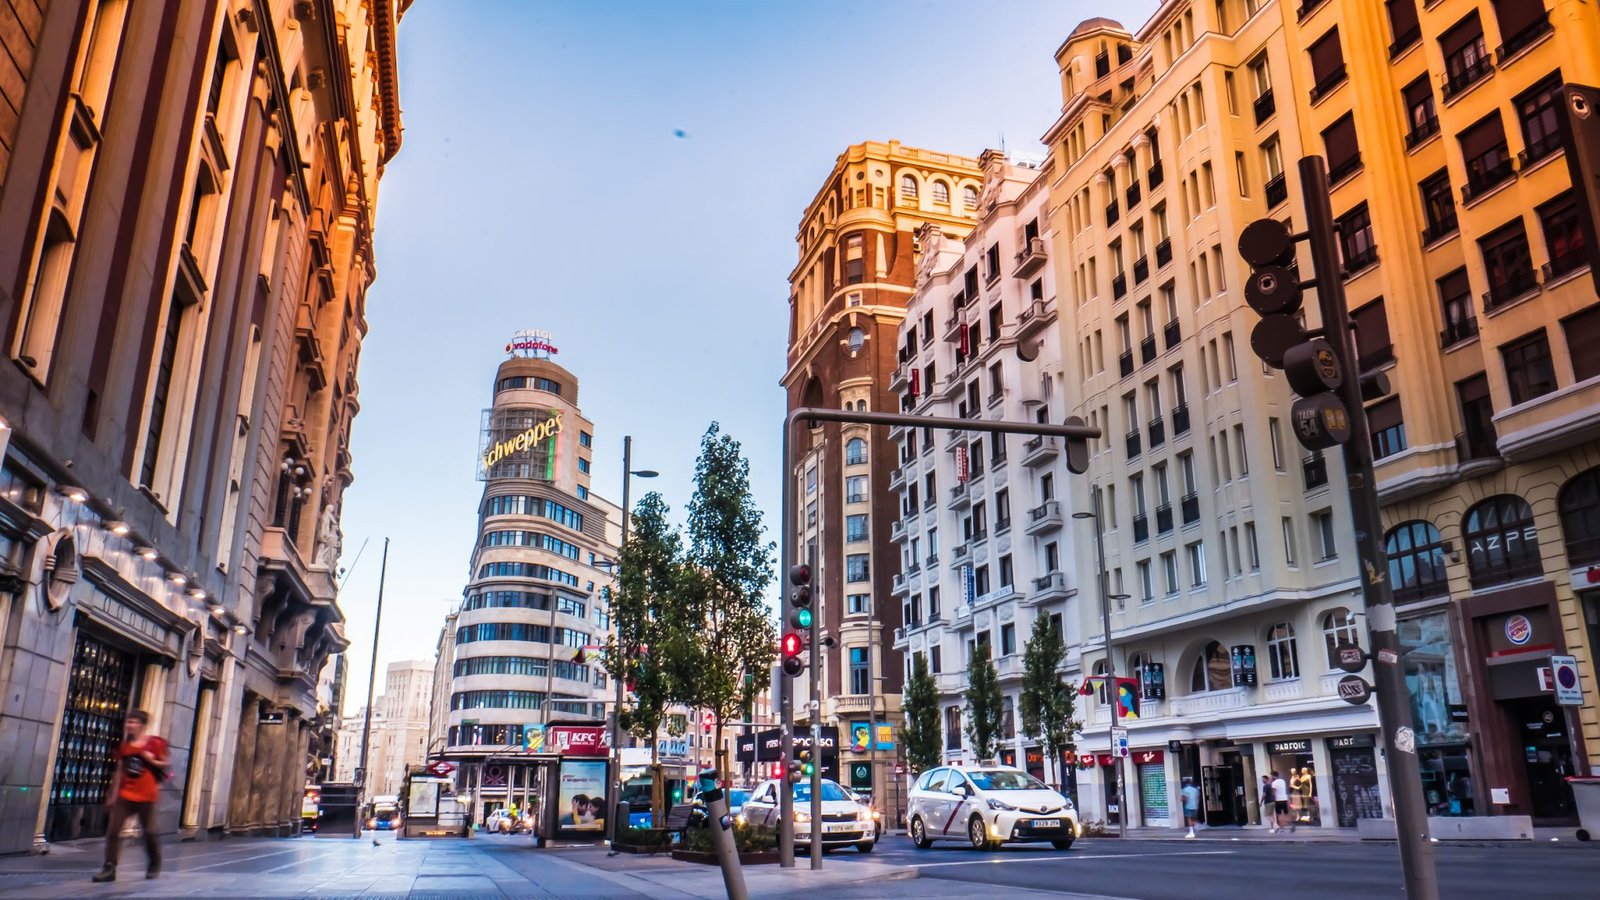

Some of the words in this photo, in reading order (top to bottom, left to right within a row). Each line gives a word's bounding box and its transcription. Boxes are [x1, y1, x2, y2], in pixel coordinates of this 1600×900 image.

[512, 340, 558, 354] vodafone
[481, 413, 563, 469] Schweppes
[1471, 526, 1538, 554] AZPE
[571, 732, 596, 742] KFC
[791, 737, 833, 747] endsa
